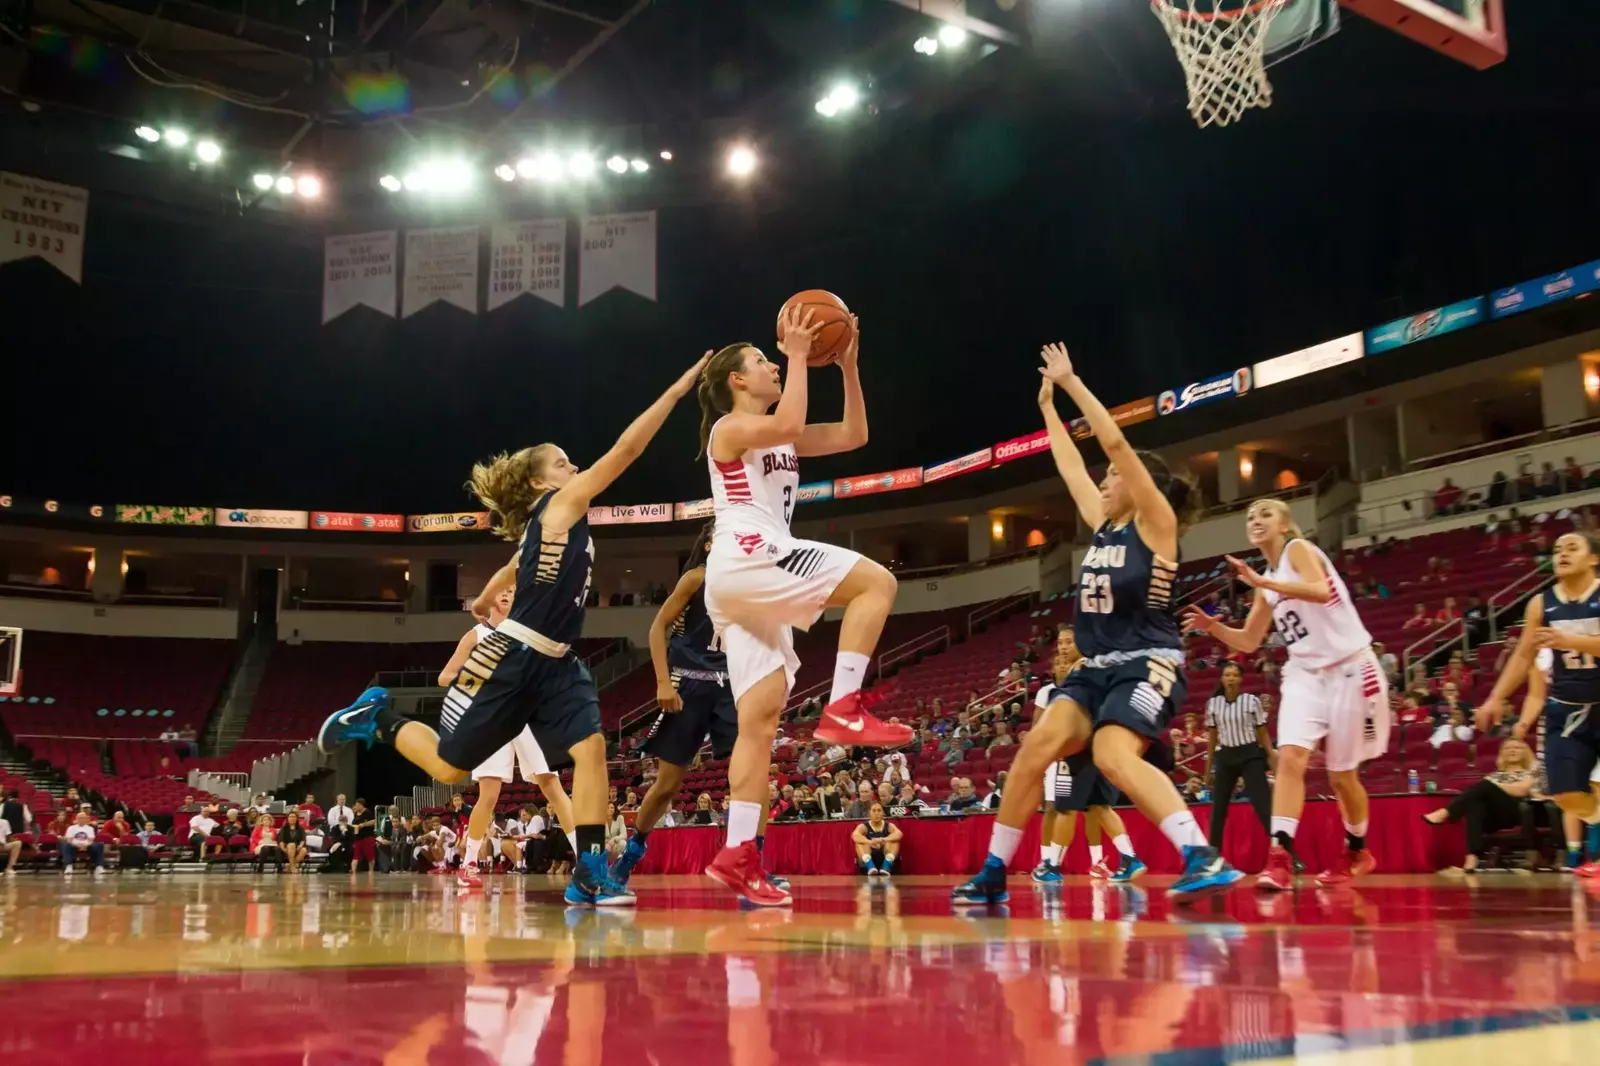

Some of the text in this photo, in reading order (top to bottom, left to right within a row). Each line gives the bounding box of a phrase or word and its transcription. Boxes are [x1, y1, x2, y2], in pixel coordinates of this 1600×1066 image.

[14, 229, 64, 253] 1983
[995, 436, 1051, 458] Office DEP
[331, 515, 353, 526] at&t
[611, 506, 635, 518] Live
[639, 505, 666, 516] Well
[377, 518, 400, 528] at&t
[412, 515, 455, 530] Corona
[1081, 572, 1113, 614] 23
[1276, 609, 1309, 645] 22
